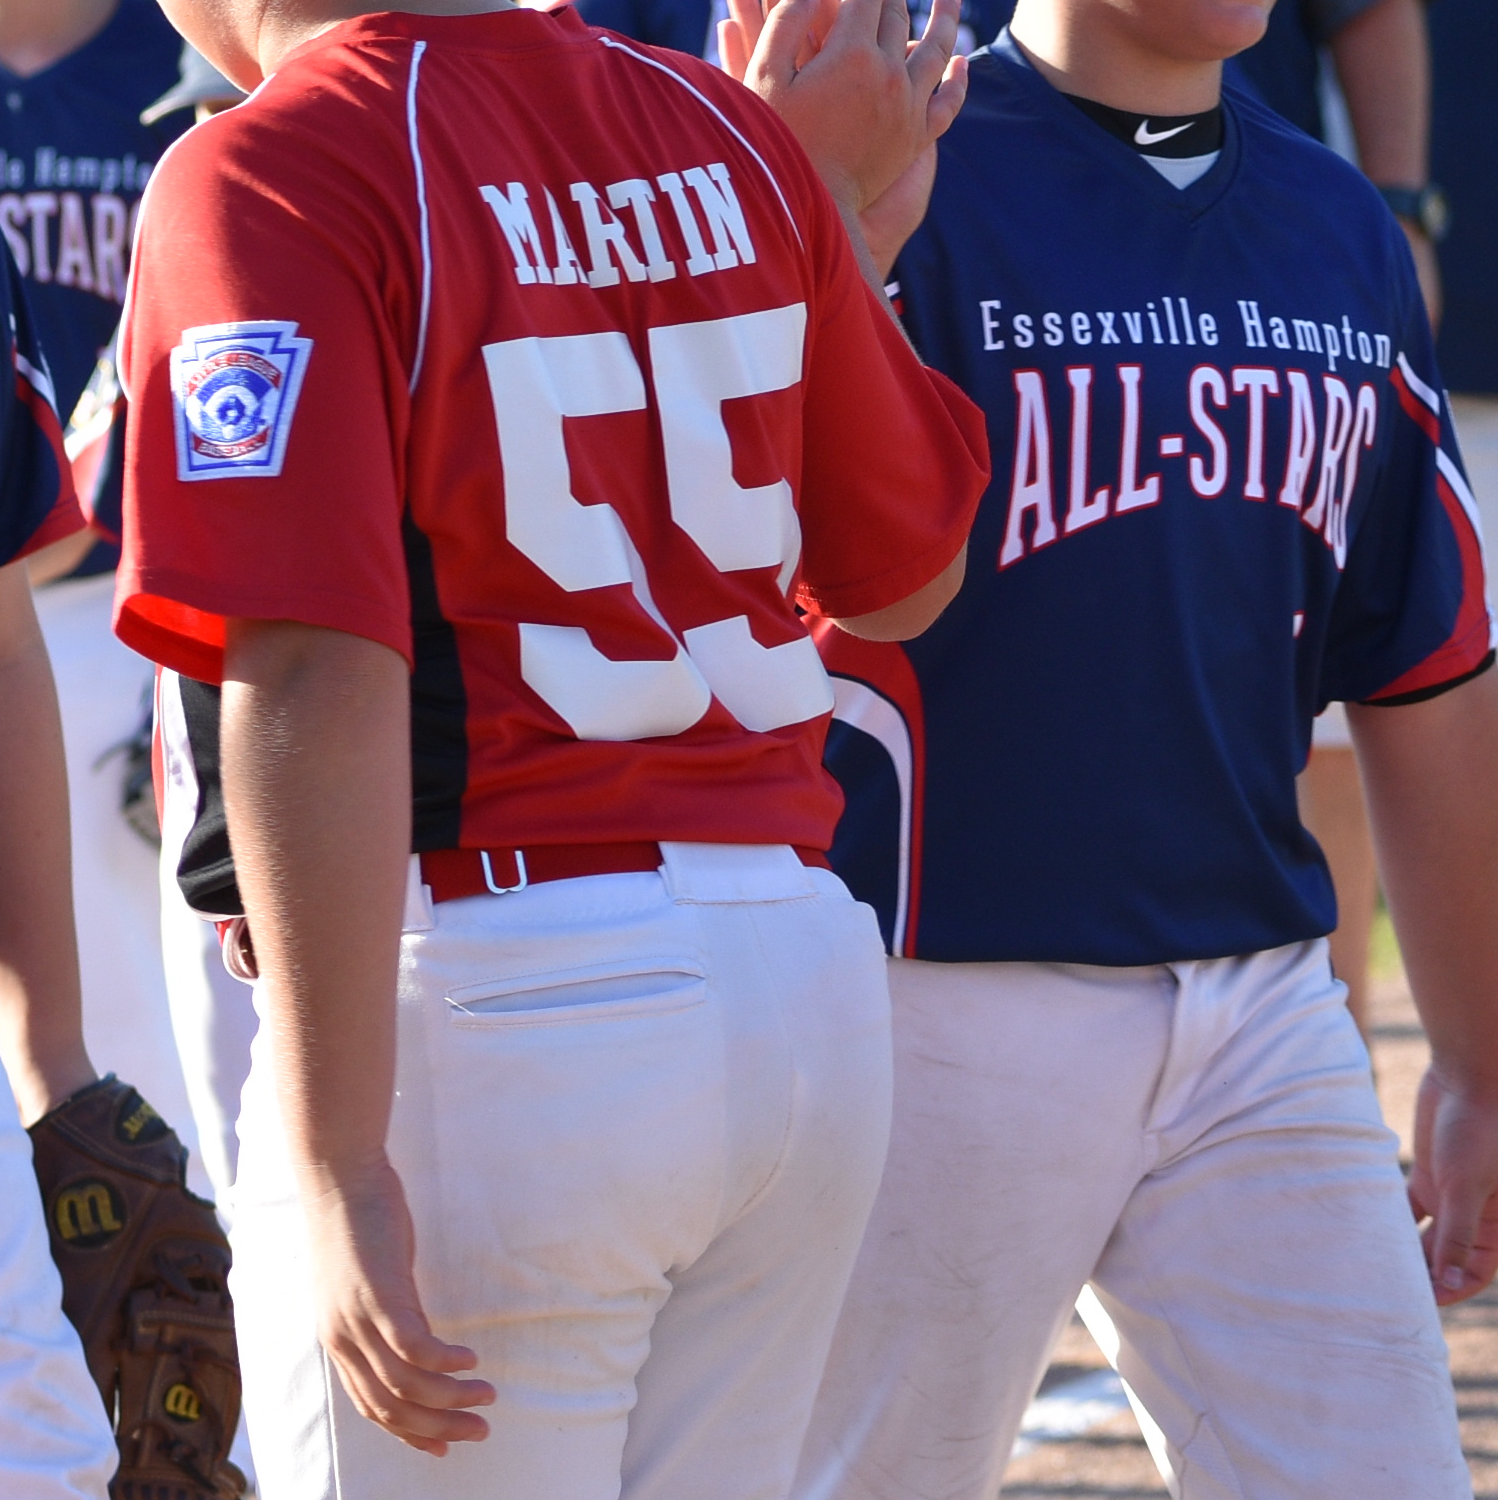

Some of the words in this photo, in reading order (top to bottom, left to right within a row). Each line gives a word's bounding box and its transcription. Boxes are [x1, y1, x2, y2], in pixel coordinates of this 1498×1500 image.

[478, 162, 757, 289] MARTIN
[979, 297, 1219, 351] Essexville
[1237, 300, 1392, 372] Hampton
[481, 301, 836, 741] 55
[997, 362, 1378, 572] ALL-STARS
